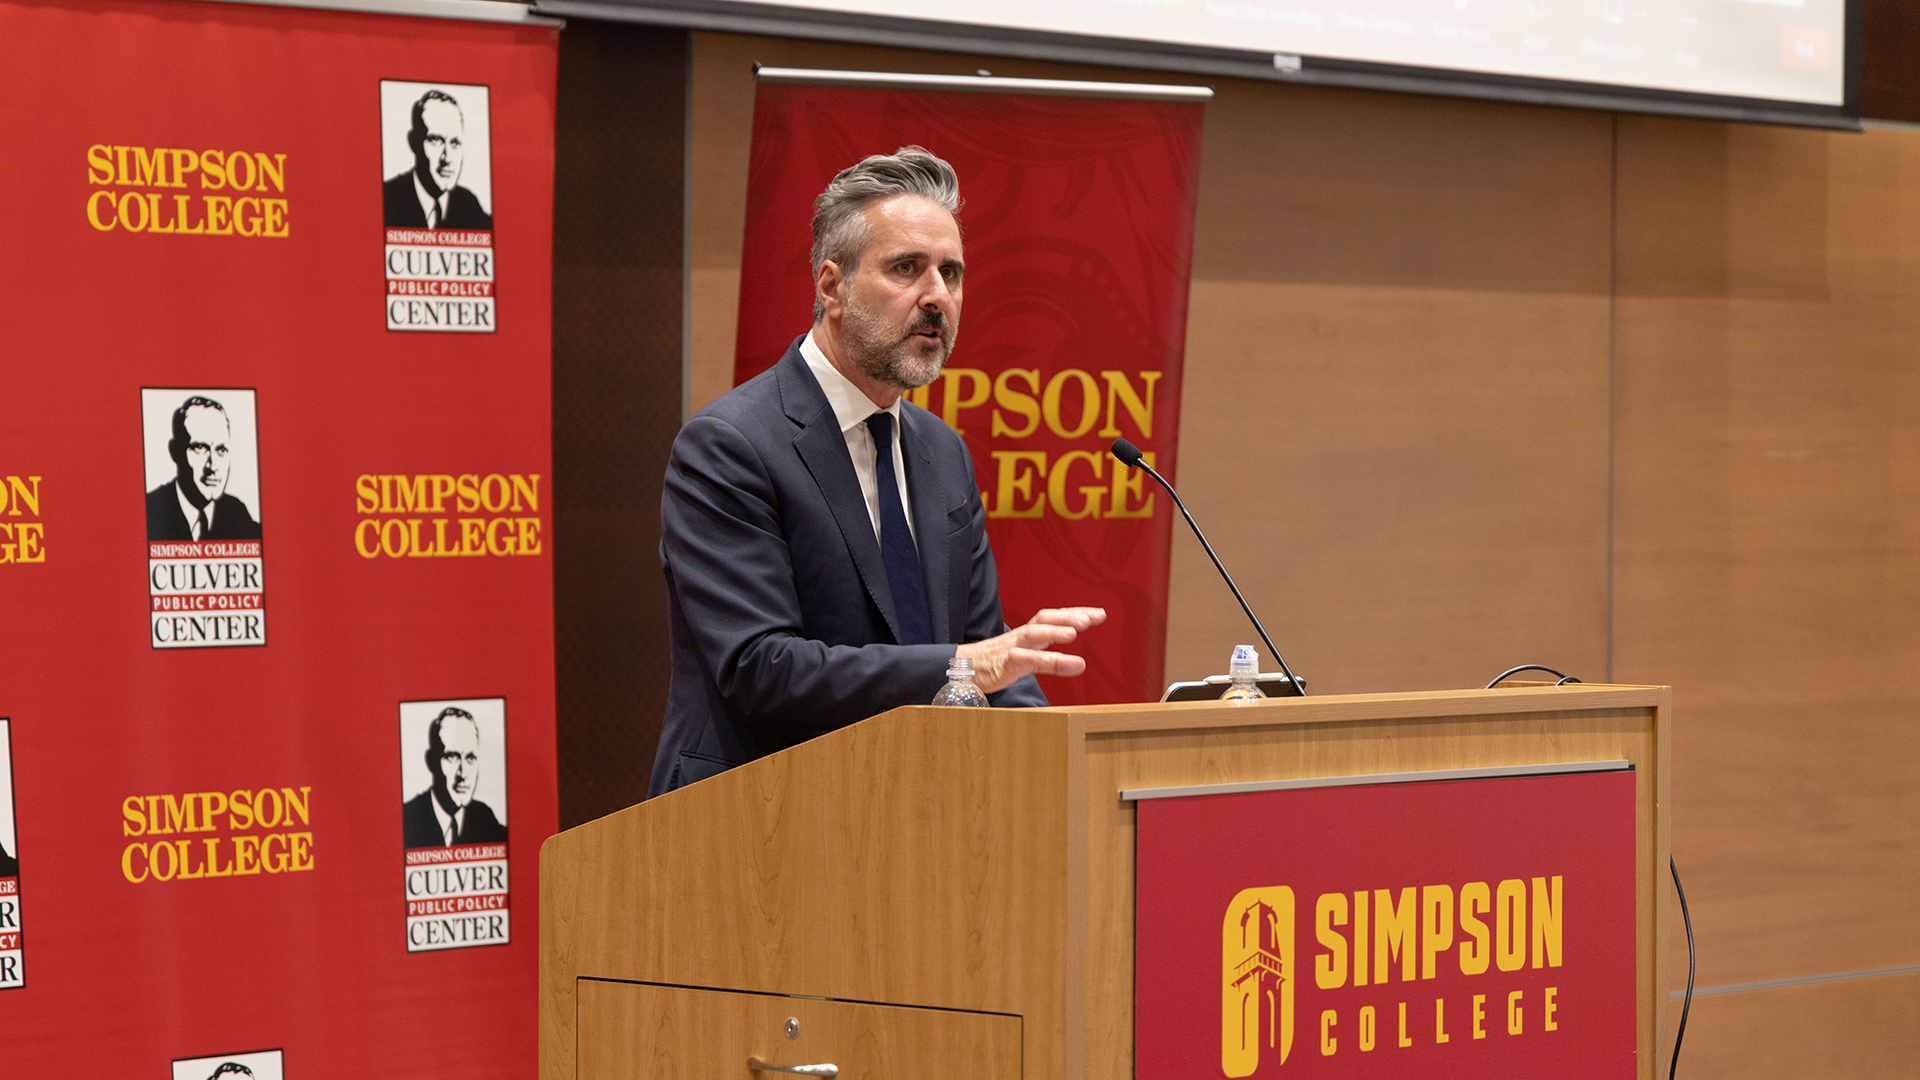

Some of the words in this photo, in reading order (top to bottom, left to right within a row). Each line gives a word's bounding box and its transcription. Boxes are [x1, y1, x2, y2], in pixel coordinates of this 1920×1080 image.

[87, 144, 287, 193] SIMPSON
[87, 191, 289, 238] COLLEGE
[386, 230, 437, 244] SIMPSON
[438, 232, 491, 246] COLLEGE
[388, 249, 490, 277] CULVER
[389, 281, 438, 295] PUBLIC
[441, 282, 490, 296] POLICY
[390, 299, 490, 326] CENTER
[902, 368, 1162, 439] PSON
[355, 474, 540, 514] SIMPSON
[150, 544, 202, 557] SIMPSON
[204, 543, 259, 556] COLLEGE
[354, 517, 542, 559] COLLEGE
[152, 562, 260, 590] CULVER
[153, 596, 204, 610] PUBLIC
[208, 595, 260, 609] POLICY
[154, 614, 261, 643] CENTER
[122, 786, 311, 837] SIMPSON
[121, 832, 315, 884] COLLEGE
[406, 849, 453, 865] SIMPSON
[454, 845, 506, 861] COLLEGE
[408, 865, 504, 895] CULVER
[409, 899, 455, 915] PUBLIC
[457, 895, 504, 911] POLICY
[410, 915, 504, 946] CENTER
[1315, 875, 1563, 990] SIMPSON
[1320, 987, 1558, 1056] COLLEGE
